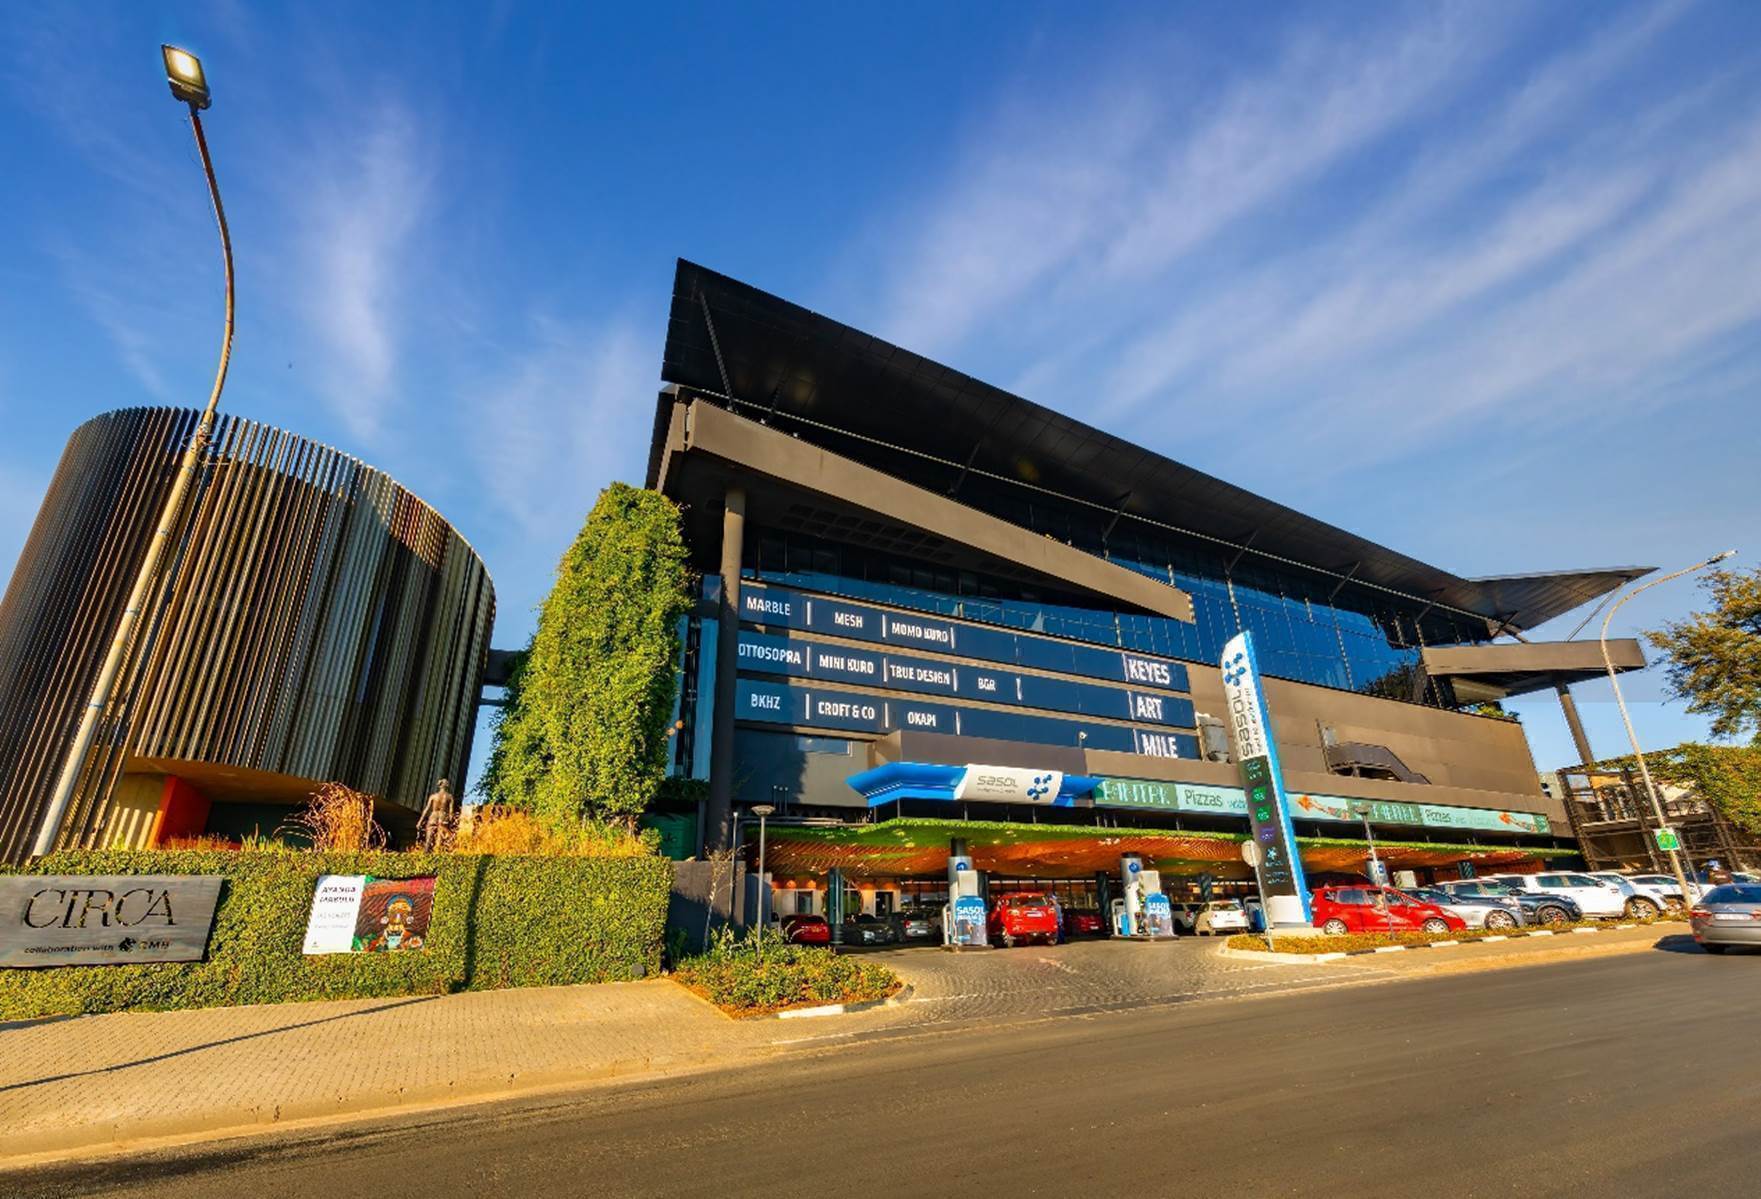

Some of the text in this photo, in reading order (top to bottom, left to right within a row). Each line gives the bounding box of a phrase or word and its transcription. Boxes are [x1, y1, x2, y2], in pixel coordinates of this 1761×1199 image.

[746, 597, 791, 616] MARBLE
[834, 611, 863, 628] MESH
[891, 622, 948, 643] MOMO KURO
[738, 643, 801, 664] OTTOSOPRA
[819, 654, 874, 674] MINI KURO
[1127, 657, 1170, 685] KEYES
[889, 664, 950, 685] TRUE DESIGN
[751, 693, 781, 710] BKHZ
[817, 701, 876, 720] CROFT & CO
[1135, 696, 1162, 720] ART
[907, 711, 936, 727] OKAPI
[1141, 733, 1179, 758] MILE
[1184, 788, 1223, 807] Pizzas
[24, 888, 177, 929] CIRCA
[24, 943, 90, 954] collaboration
[92, 944, 114, 952] with
